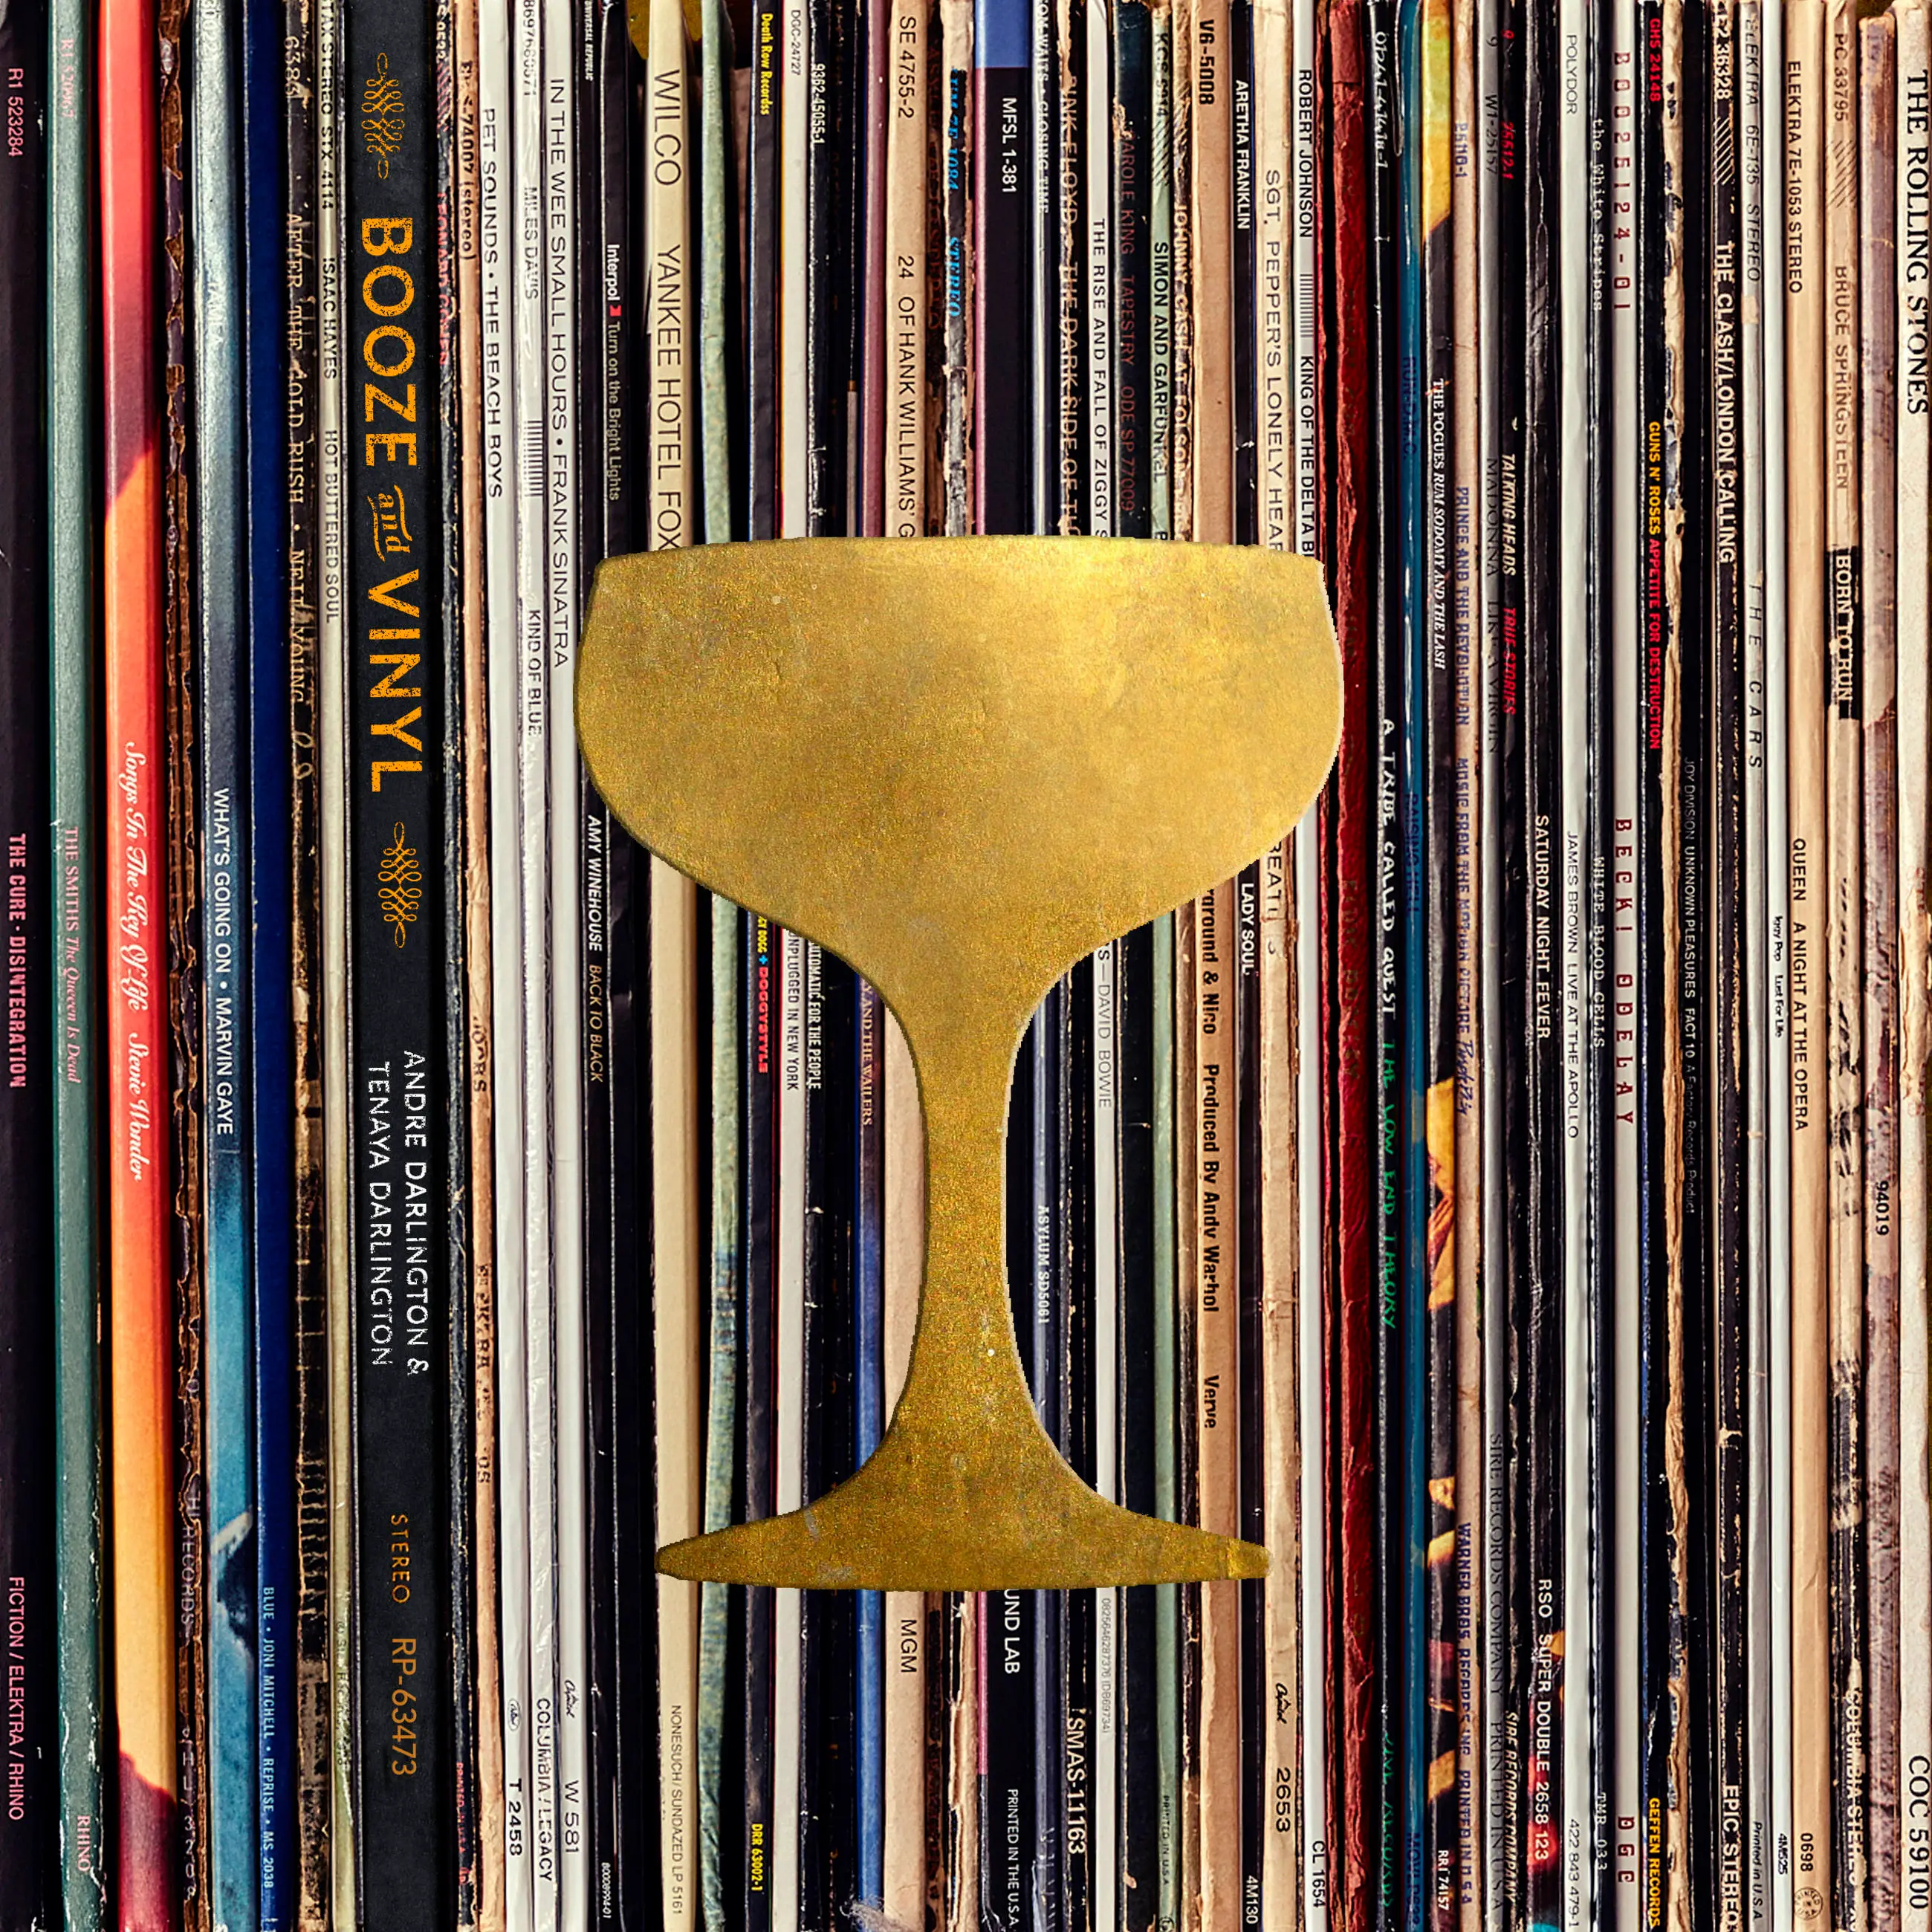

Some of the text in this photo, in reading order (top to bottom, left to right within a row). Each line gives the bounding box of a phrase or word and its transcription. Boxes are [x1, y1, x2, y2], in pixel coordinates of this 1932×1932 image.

[7, 68, 23, 157] R1 523284
[760, 13, 773, 42] Death
[760, 45, 773, 68] Row
[898, 16, 915, 118] SE 4755-2
[653, 70, 681, 186] WILCO
[1002, 97, 1016, 192] MFSL 1-381
[1235, 80, 1249, 229] ARETHA FRANKLIN
[1299, 69, 1312, 238] ROBERT JOHNSON
[1788, 61, 1802, 294] ELEKTRA 7E-1053 STEREO
[482, 108, 502, 498] PET SOUNDS THE BEACH BOYS
[550, 79, 566, 430] IN THE WEE SMALL HOURS
[606, 244, 620, 301] Interpol
[1263, 169, 1283, 477] SGT. PEPPER'S LONELY
[1906, 69, 1928, 415] THE ROLLING STONES
[606, 322, 622, 500] Turn on the Bright Lights
[657, 244, 681, 480] YANKEE HOTEL
[898, 256, 915, 516] 24 OF HANK WILLIAMS'
[1094, 218, 1107, 521] THE RISE AND FALL OF ZIGGY
[1300, 356, 1314, 534] KING OF THE DELTA
[1433, 378, 1444, 469] THE POGUES
[1716, 242, 1734, 563] THE CLASH/LONDON CALLING
[325, 430, 340, 623] HOT BUTTERED SOUL
[360, 217, 422, 792] BOOZE and VINYL
[552, 455, 568, 667] FRANK SINATRA
[1649, 421, 1661, 534] GUNS N' ROSES
[1650, 539, 1661, 749] APPETITE FOR DESTRUCTION
[1748, 584, 1762, 768] THE CARS
[1836, 555, 1852, 701] BORN TO RUN
[65, 827, 79, 931] THE SMITHS
[119, 742, 149, 1013] Songs In The Key Of Life
[588, 815, 602, 950] AMY WINEHOUSE
[1241, 883, 1254, 973] LADY SOUL
[1382, 719, 1396, 1014] A TRIBE CALLED QUEST
[1534, 815, 1551, 1039] SATURDAY NIGHT FEVER
[1567, 831, 1578, 953] JAMES BROWN
[1684, 846, 1696, 999] UNKNOWN PLEASURES
[1793, 838, 1805, 901] QUEEN
[8, 834, 26, 1087] THE CURE DISINTEGRATION
[213, 788, 233, 1134] WHAT'S GOING ON MARVIN GAYE
[589, 965, 603, 1082] BACK TO BLACK
[1098, 985, 1111, 1107] DAVID BOWIE
[1774, 975, 1784, 1037] Lust For Life
[1793, 922, 1808, 1130] A NIGHT AT THE OPERA
[129, 1033, 149, 1181] Stevie Wonder
[1567, 964, 1579, 1138] LIVE AT THE APOLLO
[368, 1061, 392, 1365] TENAYA DARLINGTON
[403, 1051, 428, 1375] ANDRE DARLINGTON &
[391, 1514, 409, 1604] STEREO
[8, 1577, 24, 1820] FICTION ELEKTRA RHINO
[263, 1586, 275, 1812] BLUE JONI MITCHELL REPRISE
[391, 1638, 416, 1776] RP-63473
[670, 1789, 683, 1915] SUNDAZED LP 5161
[1649, 1798, 1660, 1927] GEFFEN RECORDS
[1909, 1756, 1930, 1909] COC 59100
